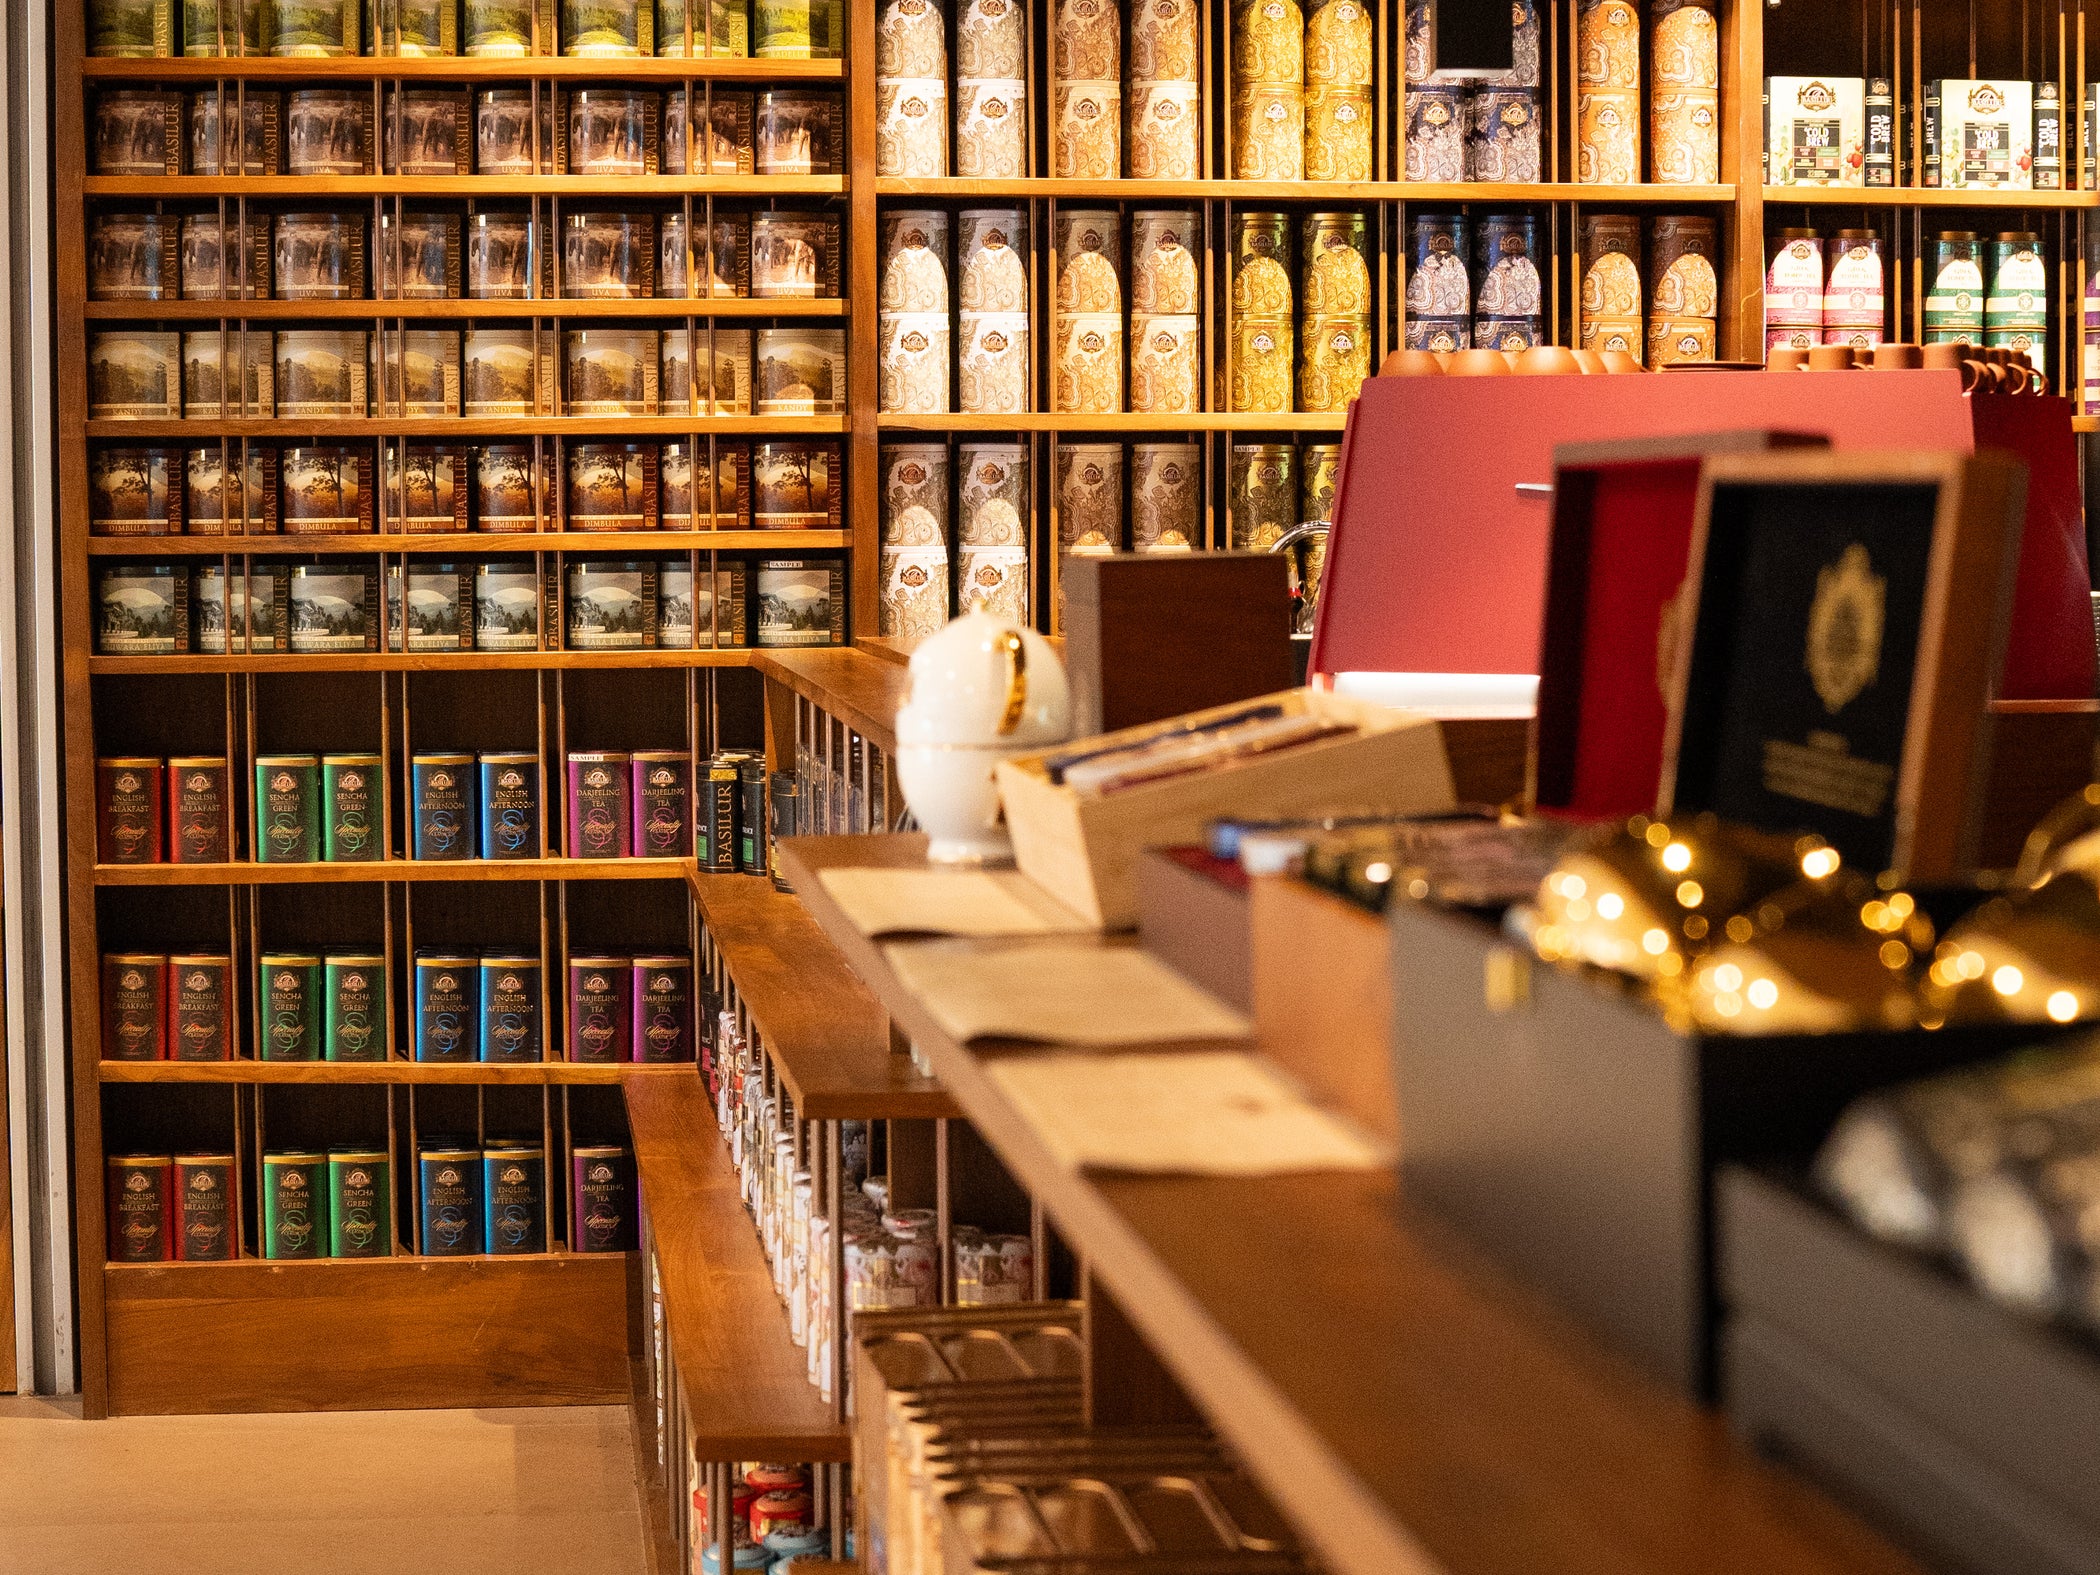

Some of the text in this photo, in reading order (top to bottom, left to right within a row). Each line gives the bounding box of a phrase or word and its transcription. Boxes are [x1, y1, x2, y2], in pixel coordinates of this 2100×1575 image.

[166, 103, 179, 166] BASILUR
[264, 104, 277, 167] BASILUR
[457, 103, 469, 166] BASILUR
[645, 104, 657, 166] BASILUR
[1805, 127, 1829, 137] COLD
[1806, 137, 1830, 147] BREW
[1871, 115, 1881, 142] COLD
[1881, 115, 1891, 143] BREW
[1926, 117, 1934, 144] BREW
[1976, 130, 1999, 140] COLD
[2039, 119, 2049, 146] COLD
[164, 226, 177, 290] BASILUR
[256, 226, 269, 290] BASILUR
[351, 225, 364, 288] BASILUR
[447, 225, 460, 288] BASILUR
[641, 225, 654, 290] BASILUR
[737, 225, 750, 288] BASILUR
[827, 224, 840, 286] BASILUR
[169, 457, 182, 521] BASILUR
[264, 457, 277, 522] BASILUR
[360, 456, 372, 519] BASILUR
[645, 454, 657, 518] BASILUR
[738, 452, 750, 516] BASILUR
[829, 453, 841, 516] BASILUR
[176, 576, 189, 640] BASILUR
[275, 576, 288, 640] BASILUR
[460, 576, 472, 637] BASILUR
[643, 573, 656, 634] BASILUR
[733, 571, 745, 634] BASILUR
[831, 571, 844, 633] BASILUR
[419, 802, 465, 810] AFTERNOON
[489, 801, 534, 809] AFTERNOON
[495, 790, 528, 798] ENGLISH
[576, 789, 620, 798] DARJEELING
[641, 788, 685, 797] DARJEELING
[718, 785, 732, 864] BASILUR
[339, 993, 370, 1001] SENCHA
[423, 1005, 470, 1013] AFTERNOON
[429, 994, 462, 1002] ENGLISH
[487, 1005, 533, 1013] AFTERNOON
[494, 994, 527, 1002] ENGLISH
[575, 994, 619, 1003] DARJEELING
[641, 994, 686, 1003] DARJEELING
[187, 1192, 220, 1200] ENGLISH
[343, 1189, 374, 1197] SENCHA
[491, 1196, 536, 1204] AFTERNOON
[497, 1186, 530, 1194] ENGLISH
[580, 1184, 624, 1192] DARJEELING
[184, 1203, 224, 1211] BREAKFAST
[347, 1200, 372, 1208] GREEN
